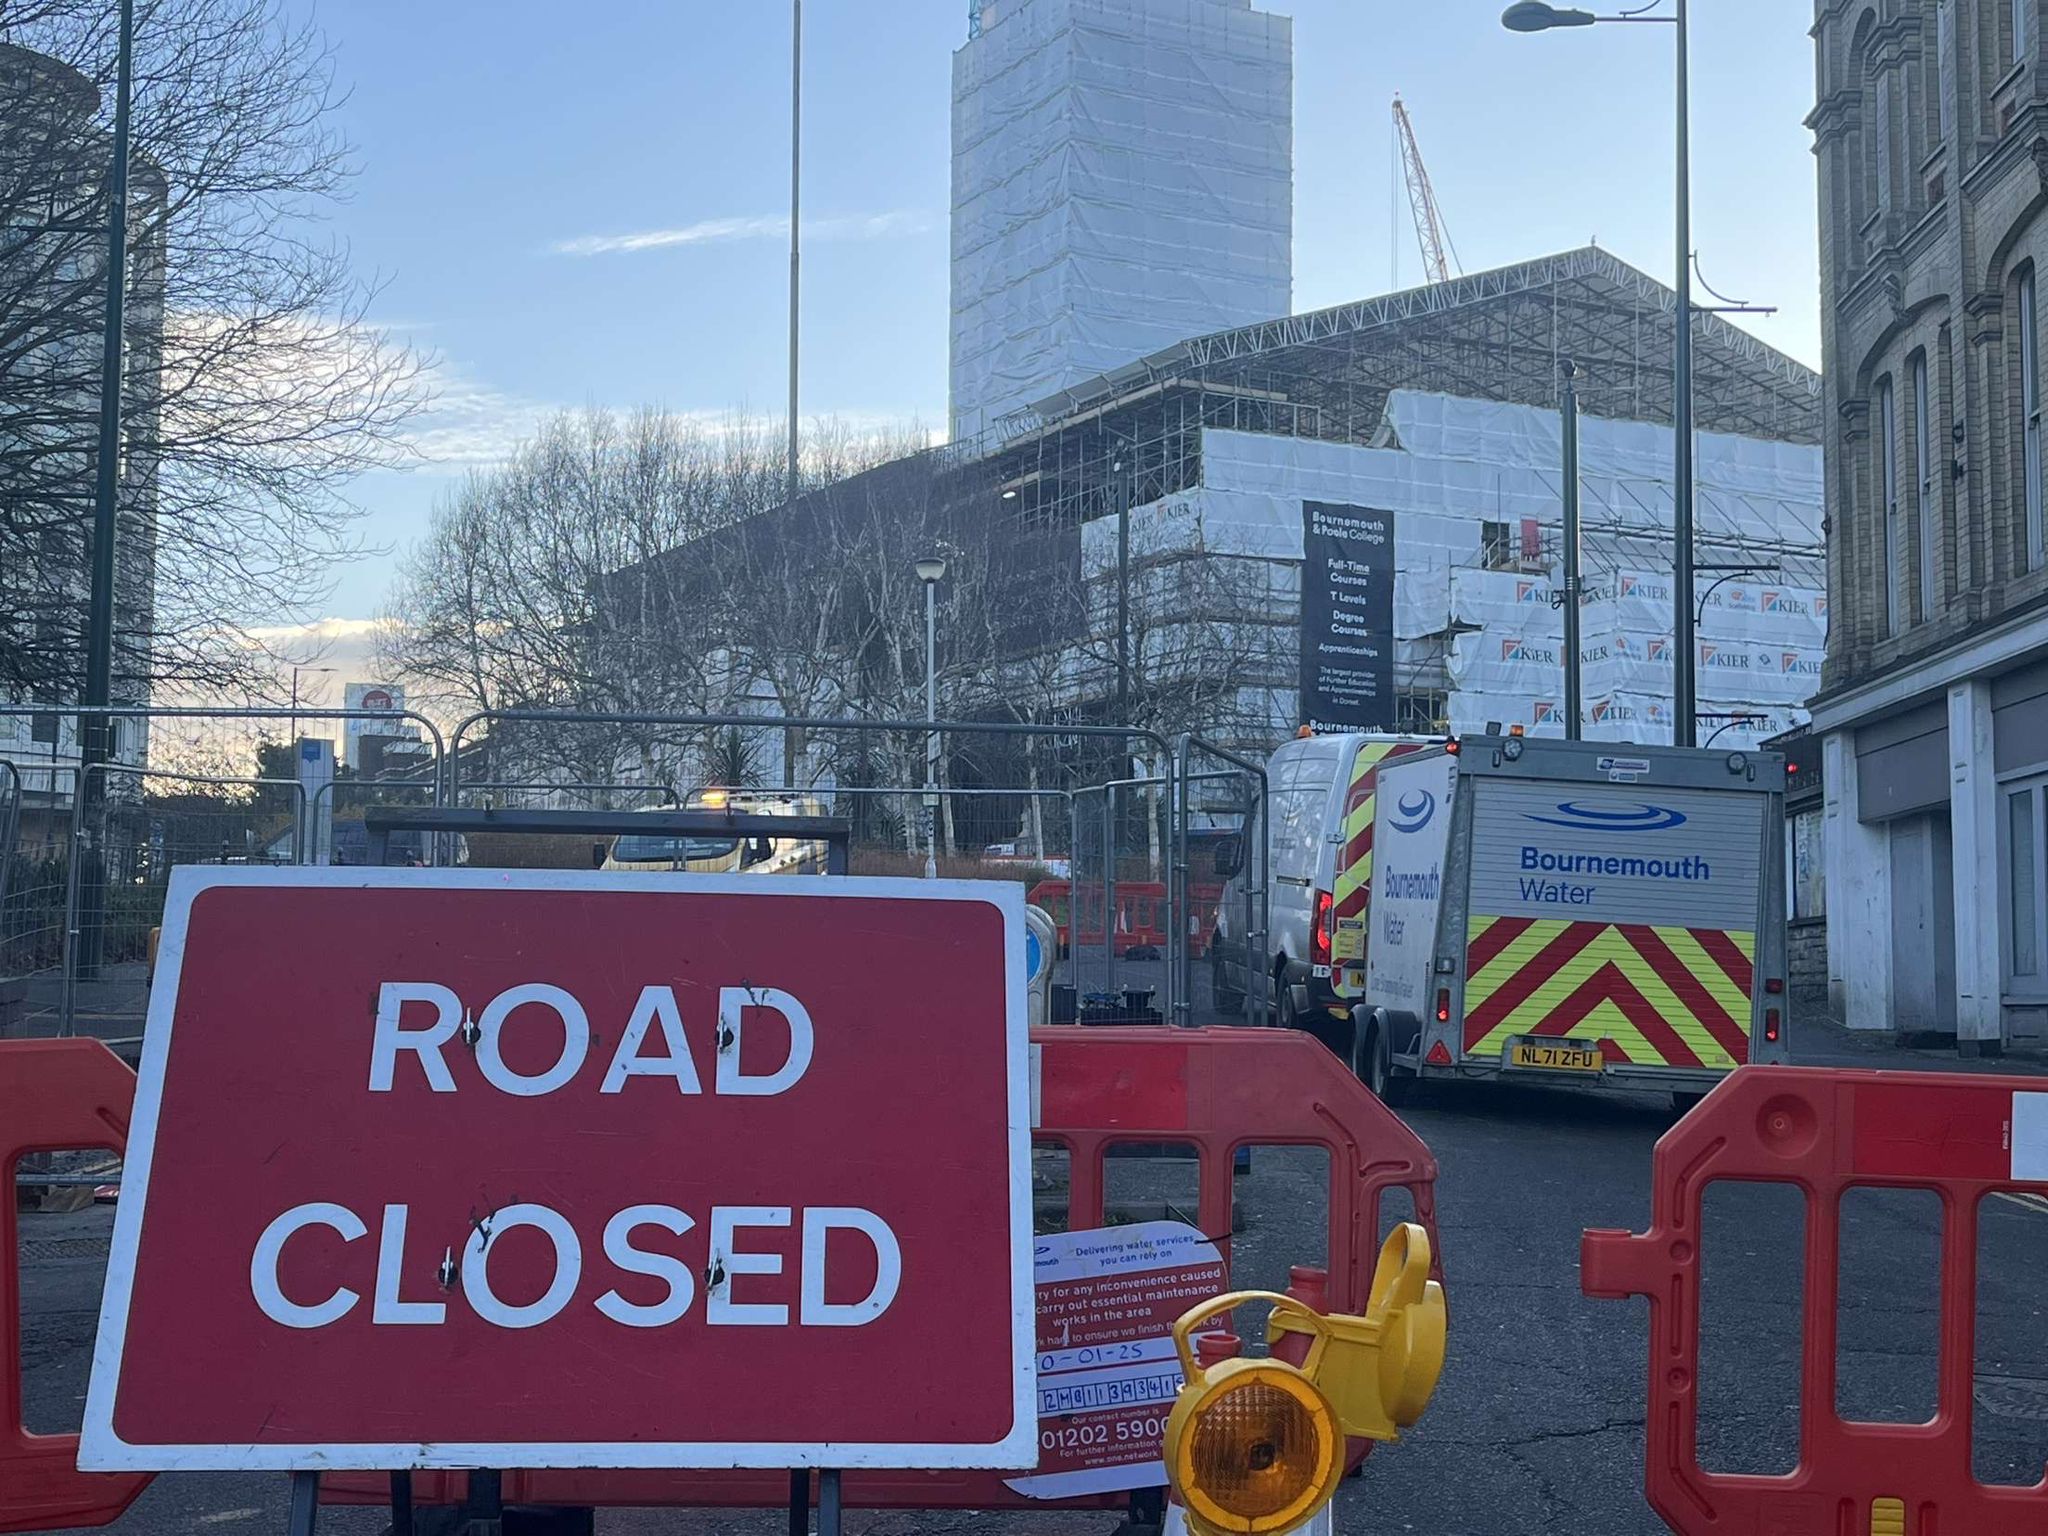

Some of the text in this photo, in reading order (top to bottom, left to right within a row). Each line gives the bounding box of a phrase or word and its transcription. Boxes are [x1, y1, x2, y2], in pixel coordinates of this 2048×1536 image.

[1312, 511, 1385, 531] Bournemouth
[1312, 523, 1385, 545] & Poole College
[1328, 558, 1370, 573] Full-Time
[1330, 572, 1367, 586] Courses
[1330, 591, 1367, 605] T Levels
[1637, 584, 1669, 600] KIER
[1779, 599, 1809, 614] KIER
[1333, 610, 1364, 623] Degree
[1331, 623, 1368, 637] Courses
[1319, 643, 1378, 657] Apprenticeships
[1521, 647, 1554, 663] KIER
[1581, 645, 1609, 662] KIER
[1717, 653, 1750, 669] KIER
[1798, 661, 1822, 674] KIE
[1310, 719, 1384, 733] Bournemouth
[1748, 719, 1778, 732] KIER
[1521, 846, 1710, 880] Bournemouth
[1385, 862, 1440, 900] Bournemouth
[1520, 876, 1596, 905] Water
[1382, 911, 1405, 946] Water
[368, 982, 814, 1096] ROAD
[1521, 1048, 1592, 1067] NL71 ZFU
[1075, 1234, 1195, 1257] Delivering water services
[250, 1202, 902, 1328] CLOSED
[1100, 1250, 1173, 1267] you can rely on
[1053, 1286, 1070, 1298] for
[1073, 1285, 1093, 1298] any
[1097, 1271, 1178, 1293] inconvenience
[1180, 1268, 1222, 1284] caused
[1036, 1284, 1219, 1315] carry out essential maintenance
[1052, 1306, 1152, 1328] works in the area
[1072, 1333, 1082, 1342] to
[1084, 1330, 1119, 1341] ensure
[1120, 1328, 1136, 1336] we
[1137, 1322, 1165, 1335] finish
[1210, 1315, 1224, 1328] by
[1041, 1343, 1143, 1371] 0-01-25
[1072, 1407, 1160, 1425] Our contact number is
[1041, 1424, 1108, 1450] 01202
[1060, 1448, 1074, 1458] For
[1076, 1444, 1106, 1457] further
[1107, 1439, 1157, 1452] information
[1084, 1451, 1159, 1466] www.one.network
